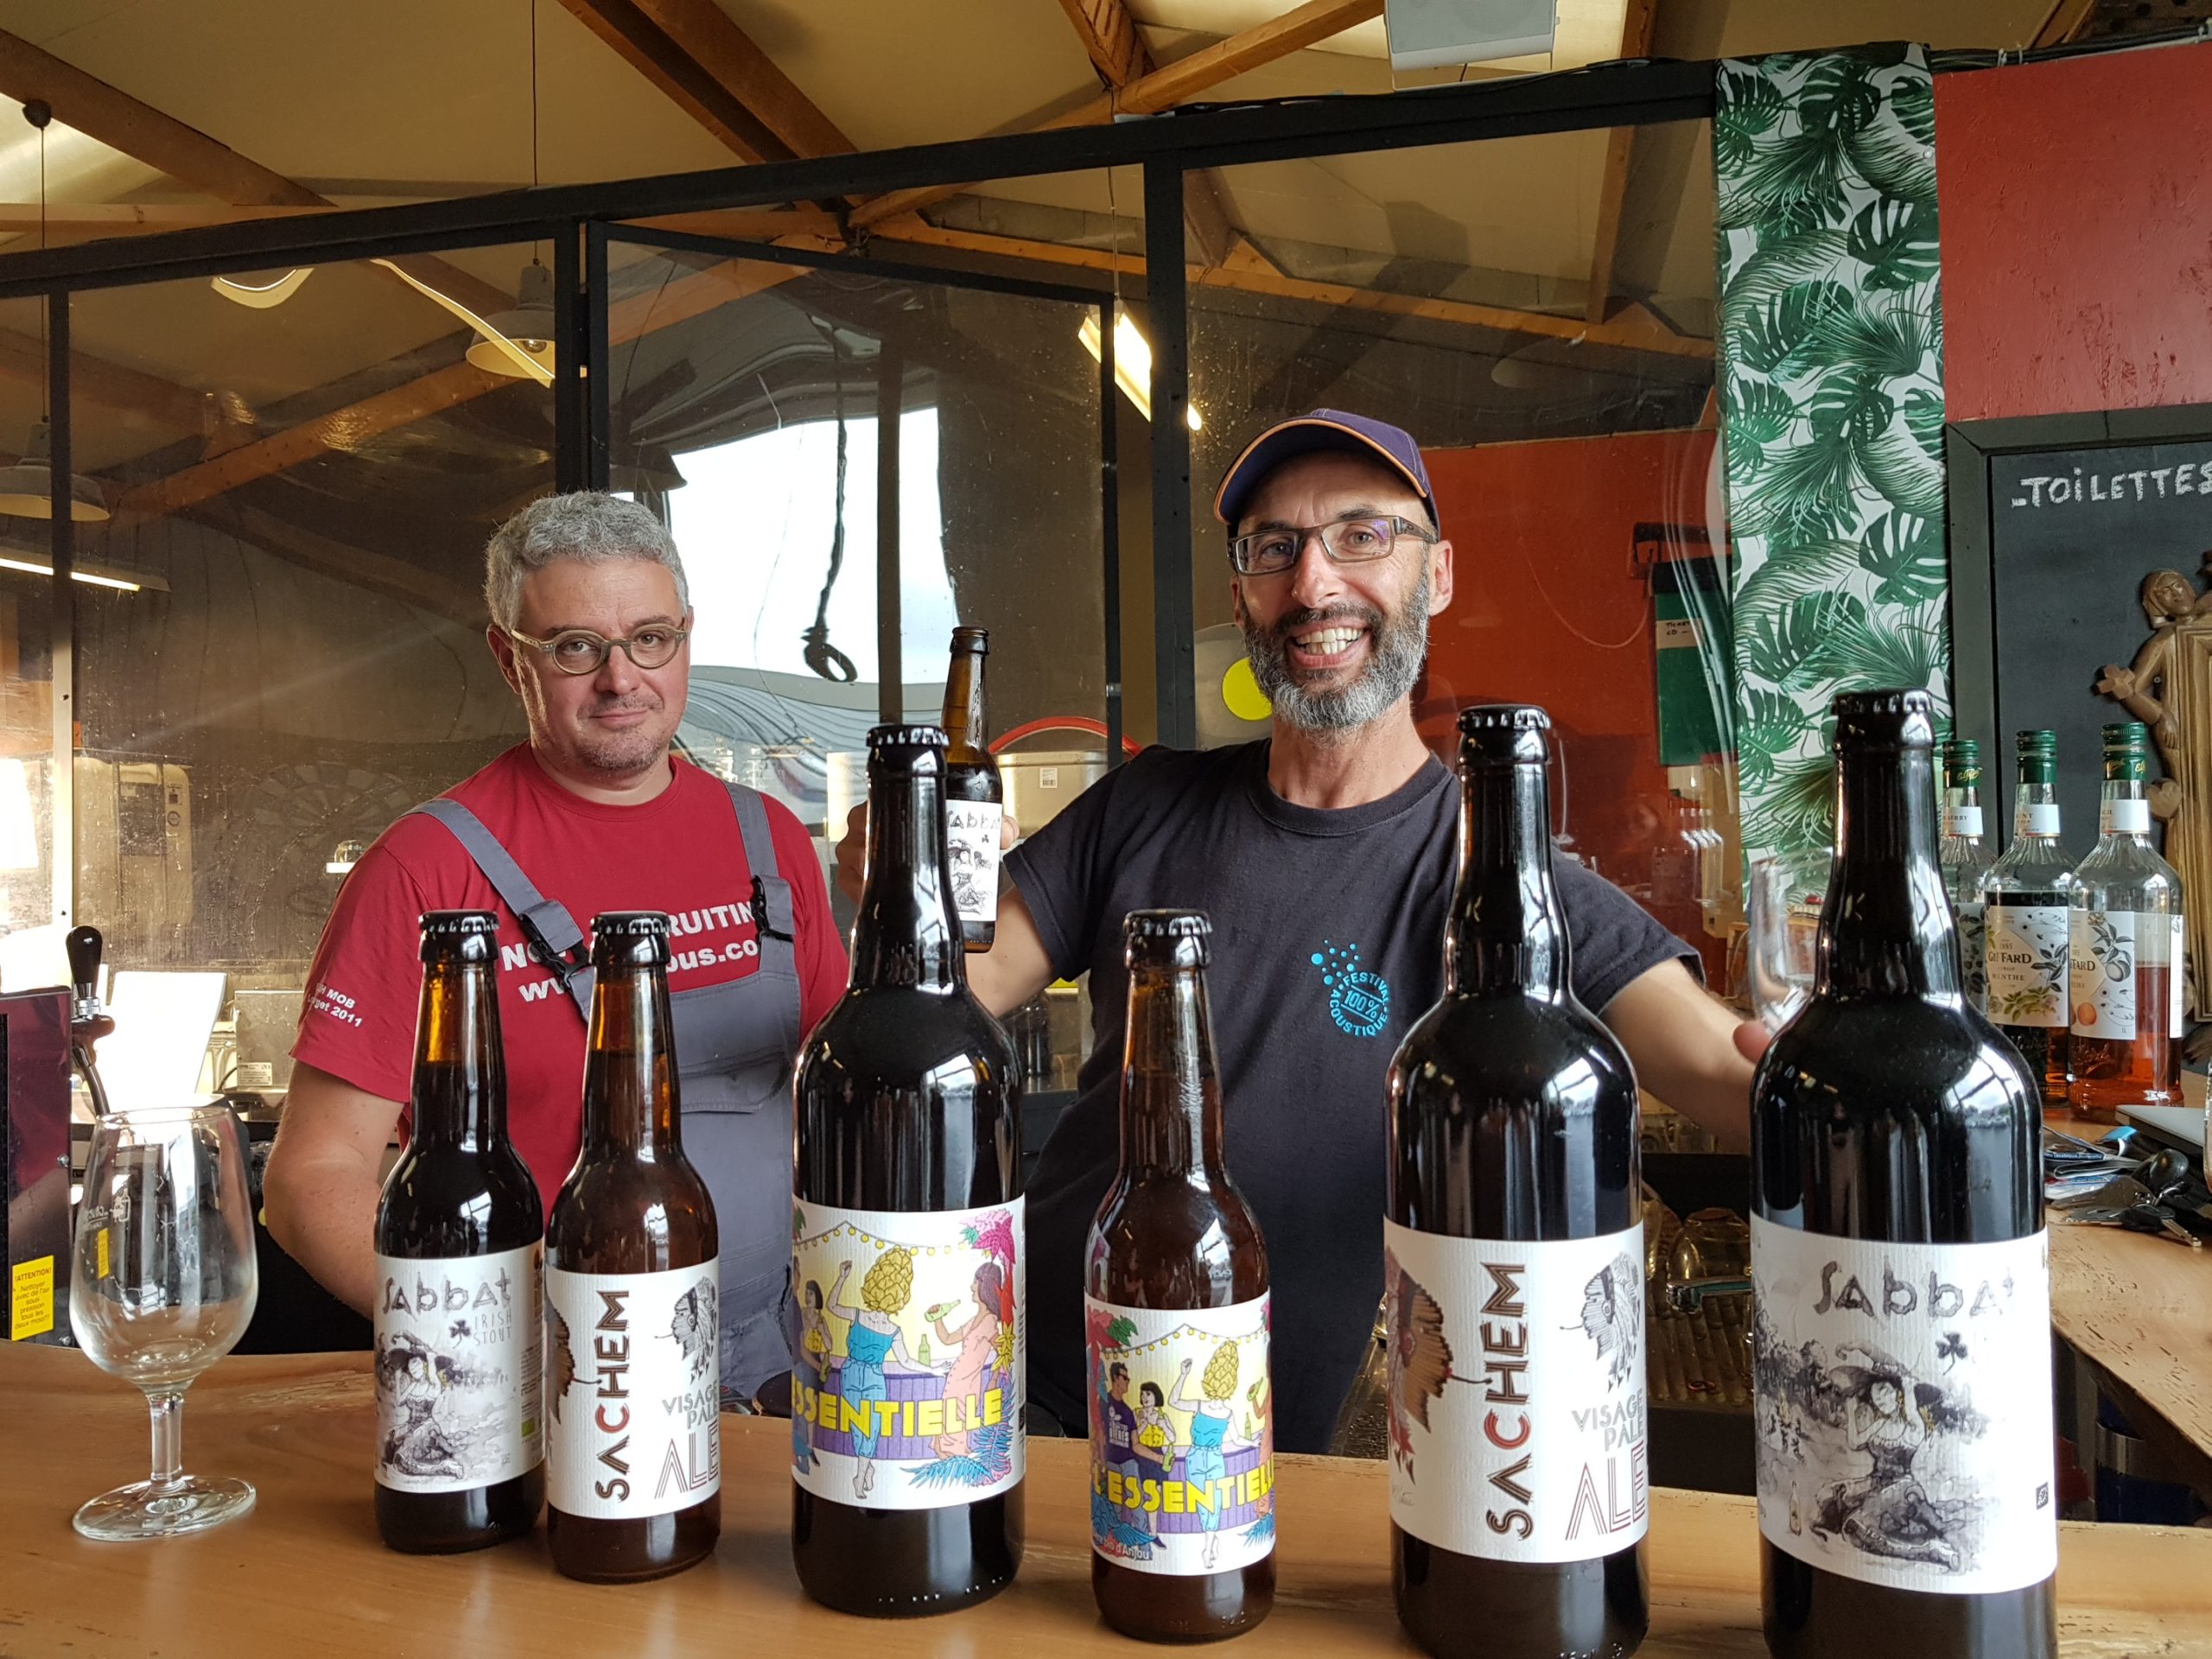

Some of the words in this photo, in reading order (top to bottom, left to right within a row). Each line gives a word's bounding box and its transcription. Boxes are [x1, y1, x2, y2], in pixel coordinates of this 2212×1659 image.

[666, 901, 756, 938] RUITIN
[327, 988, 355, 1009] MOB
[1343, 972, 1389, 1004] FESTIVAL
[1344, 990, 1381, 1020] 100%
[330, 1007, 363, 1027] 2011
[1330, 988, 1388, 1036] ACOUSTIQUE
[474, 1309, 512, 1329] IRISH
[474, 1326, 512, 1345] STOUT
[595, 1290, 630, 1502] SACHEM
[662, 1380, 718, 1415] VISAGE
[1480, 1262, 1534, 1541] SACHEM
[1572, 1387, 1643, 1433] VISAGE
[687, 1402, 718, 1429] PALE
[1604, 1413, 1643, 1452] PALE
[654, 1419, 719, 1499] ALE
[1565, 1440, 1645, 1541] ALE
[1116, 1542, 1150, 1561] d'Anjou
